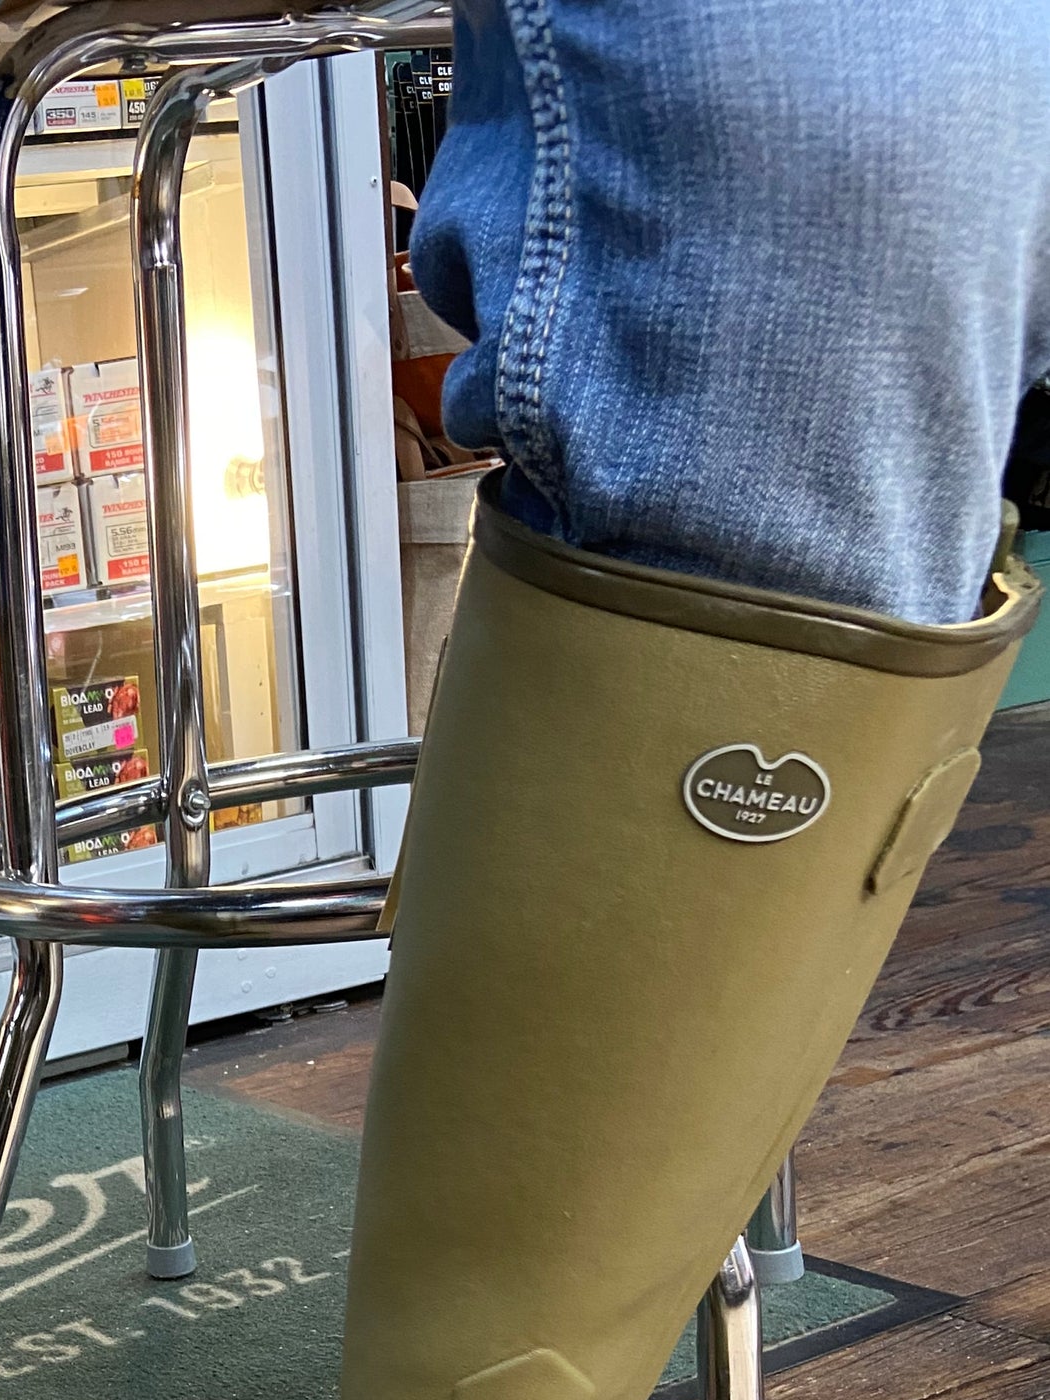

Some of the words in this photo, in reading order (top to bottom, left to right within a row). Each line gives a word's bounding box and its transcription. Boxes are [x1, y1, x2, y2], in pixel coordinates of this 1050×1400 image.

[83, 703, 104, 715] LEAD
[89, 777, 110, 789] LEAD
[754, 773, 773, 786] LE
[696, 778, 818, 815] CHAMEAU
[735, 809, 767, 824] 1927
[140, 1256, 340, 1320] 1932
